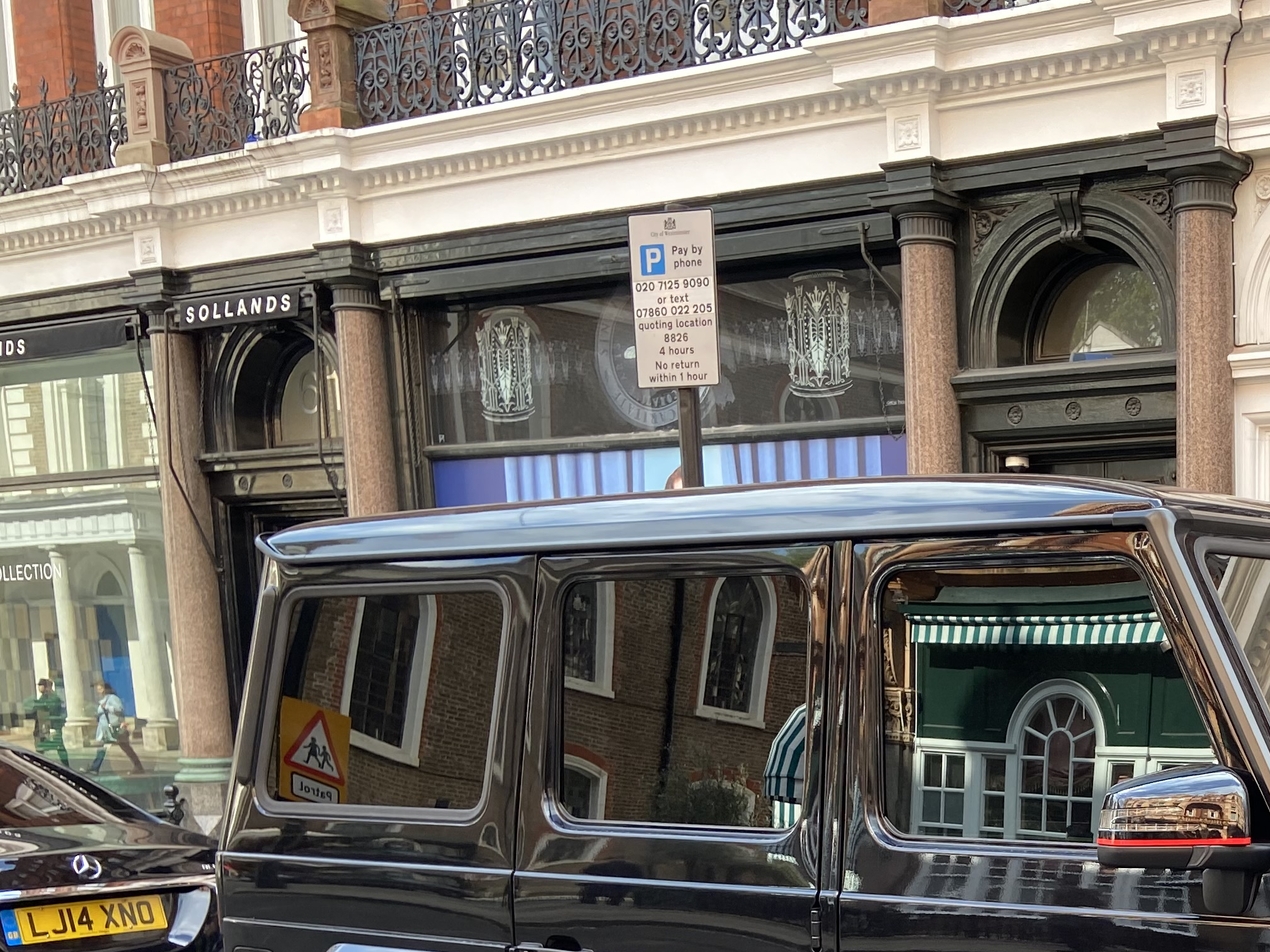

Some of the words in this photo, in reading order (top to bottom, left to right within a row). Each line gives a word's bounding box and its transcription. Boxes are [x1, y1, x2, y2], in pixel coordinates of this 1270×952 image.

[671, 245, 688, 256] Pay
[691, 244, 703, 255] by
[645, 248, 661, 273] P
[673, 258, 702, 270] phone
[635, 282, 655, 292] 020
[658, 279, 680, 291] 7125
[683, 277, 709, 289] 9090
[670, 293, 689, 304] text
[186, 293, 291, 324] SOLLANDS
[636, 307, 668, 318] 07860
[670, 305, 690, 316] 022
[693, 303, 713, 314] 205
[638, 320, 673, 332] quoting
[676, 318, 713, 329] location
[664, 332, 689, 343] 8826
[0, 339, 26, 357] DS
[659, 346, 666, 356] 4
[669, 345, 695, 355] hours
[655, 360, 668, 370] No
[671, 360, 700, 370] return
[649, 372, 677, 383] within
[687, 371, 708, 381] hour
[27, 906, 94, 938] LJ14
[99, 900, 155, 929] XNO
